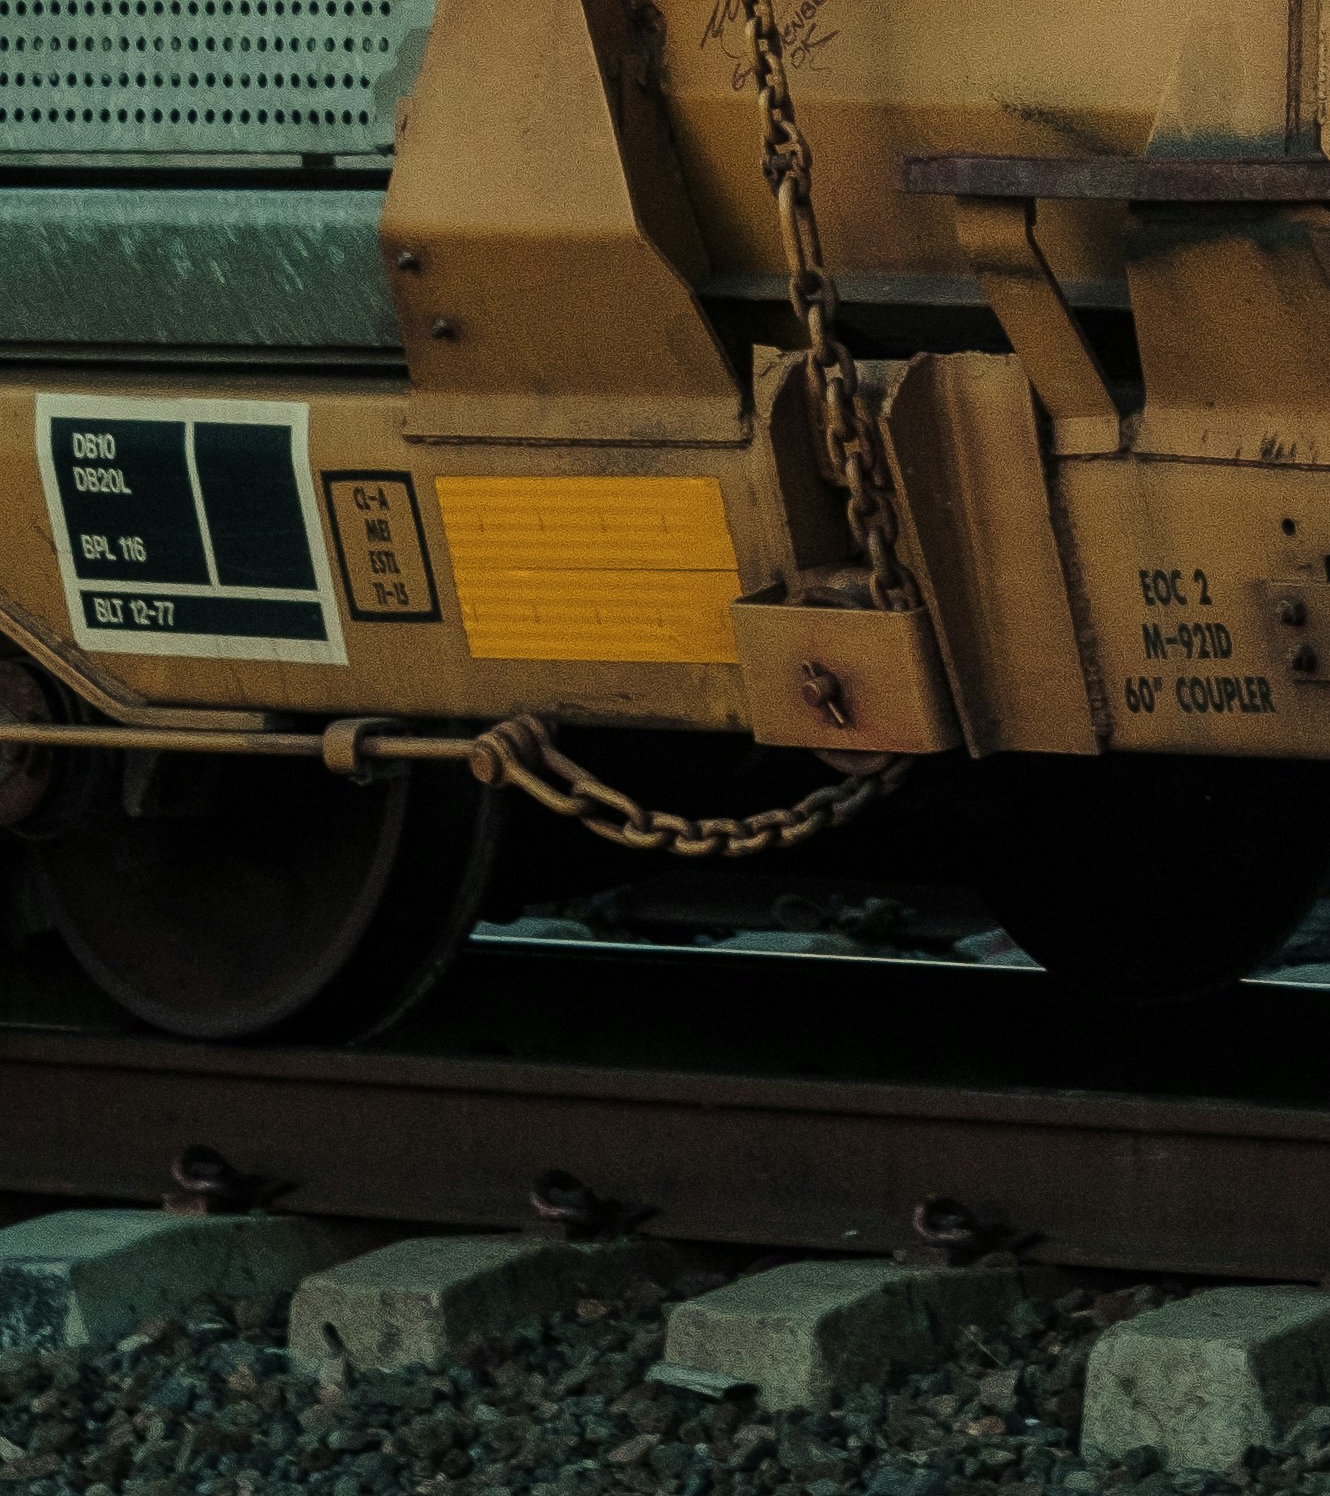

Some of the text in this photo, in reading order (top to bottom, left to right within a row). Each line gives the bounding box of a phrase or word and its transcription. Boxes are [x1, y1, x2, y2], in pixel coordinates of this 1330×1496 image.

[72, 432, 115, 459] DB10
[73, 467, 132, 495] DB20L
[81, 534, 146, 562] BPL 116
[1139, 568, 1212, 606] EOC 2
[94, 598, 174, 626] BLT 12-77
[1176, 676, 1276, 713] COUPLER
